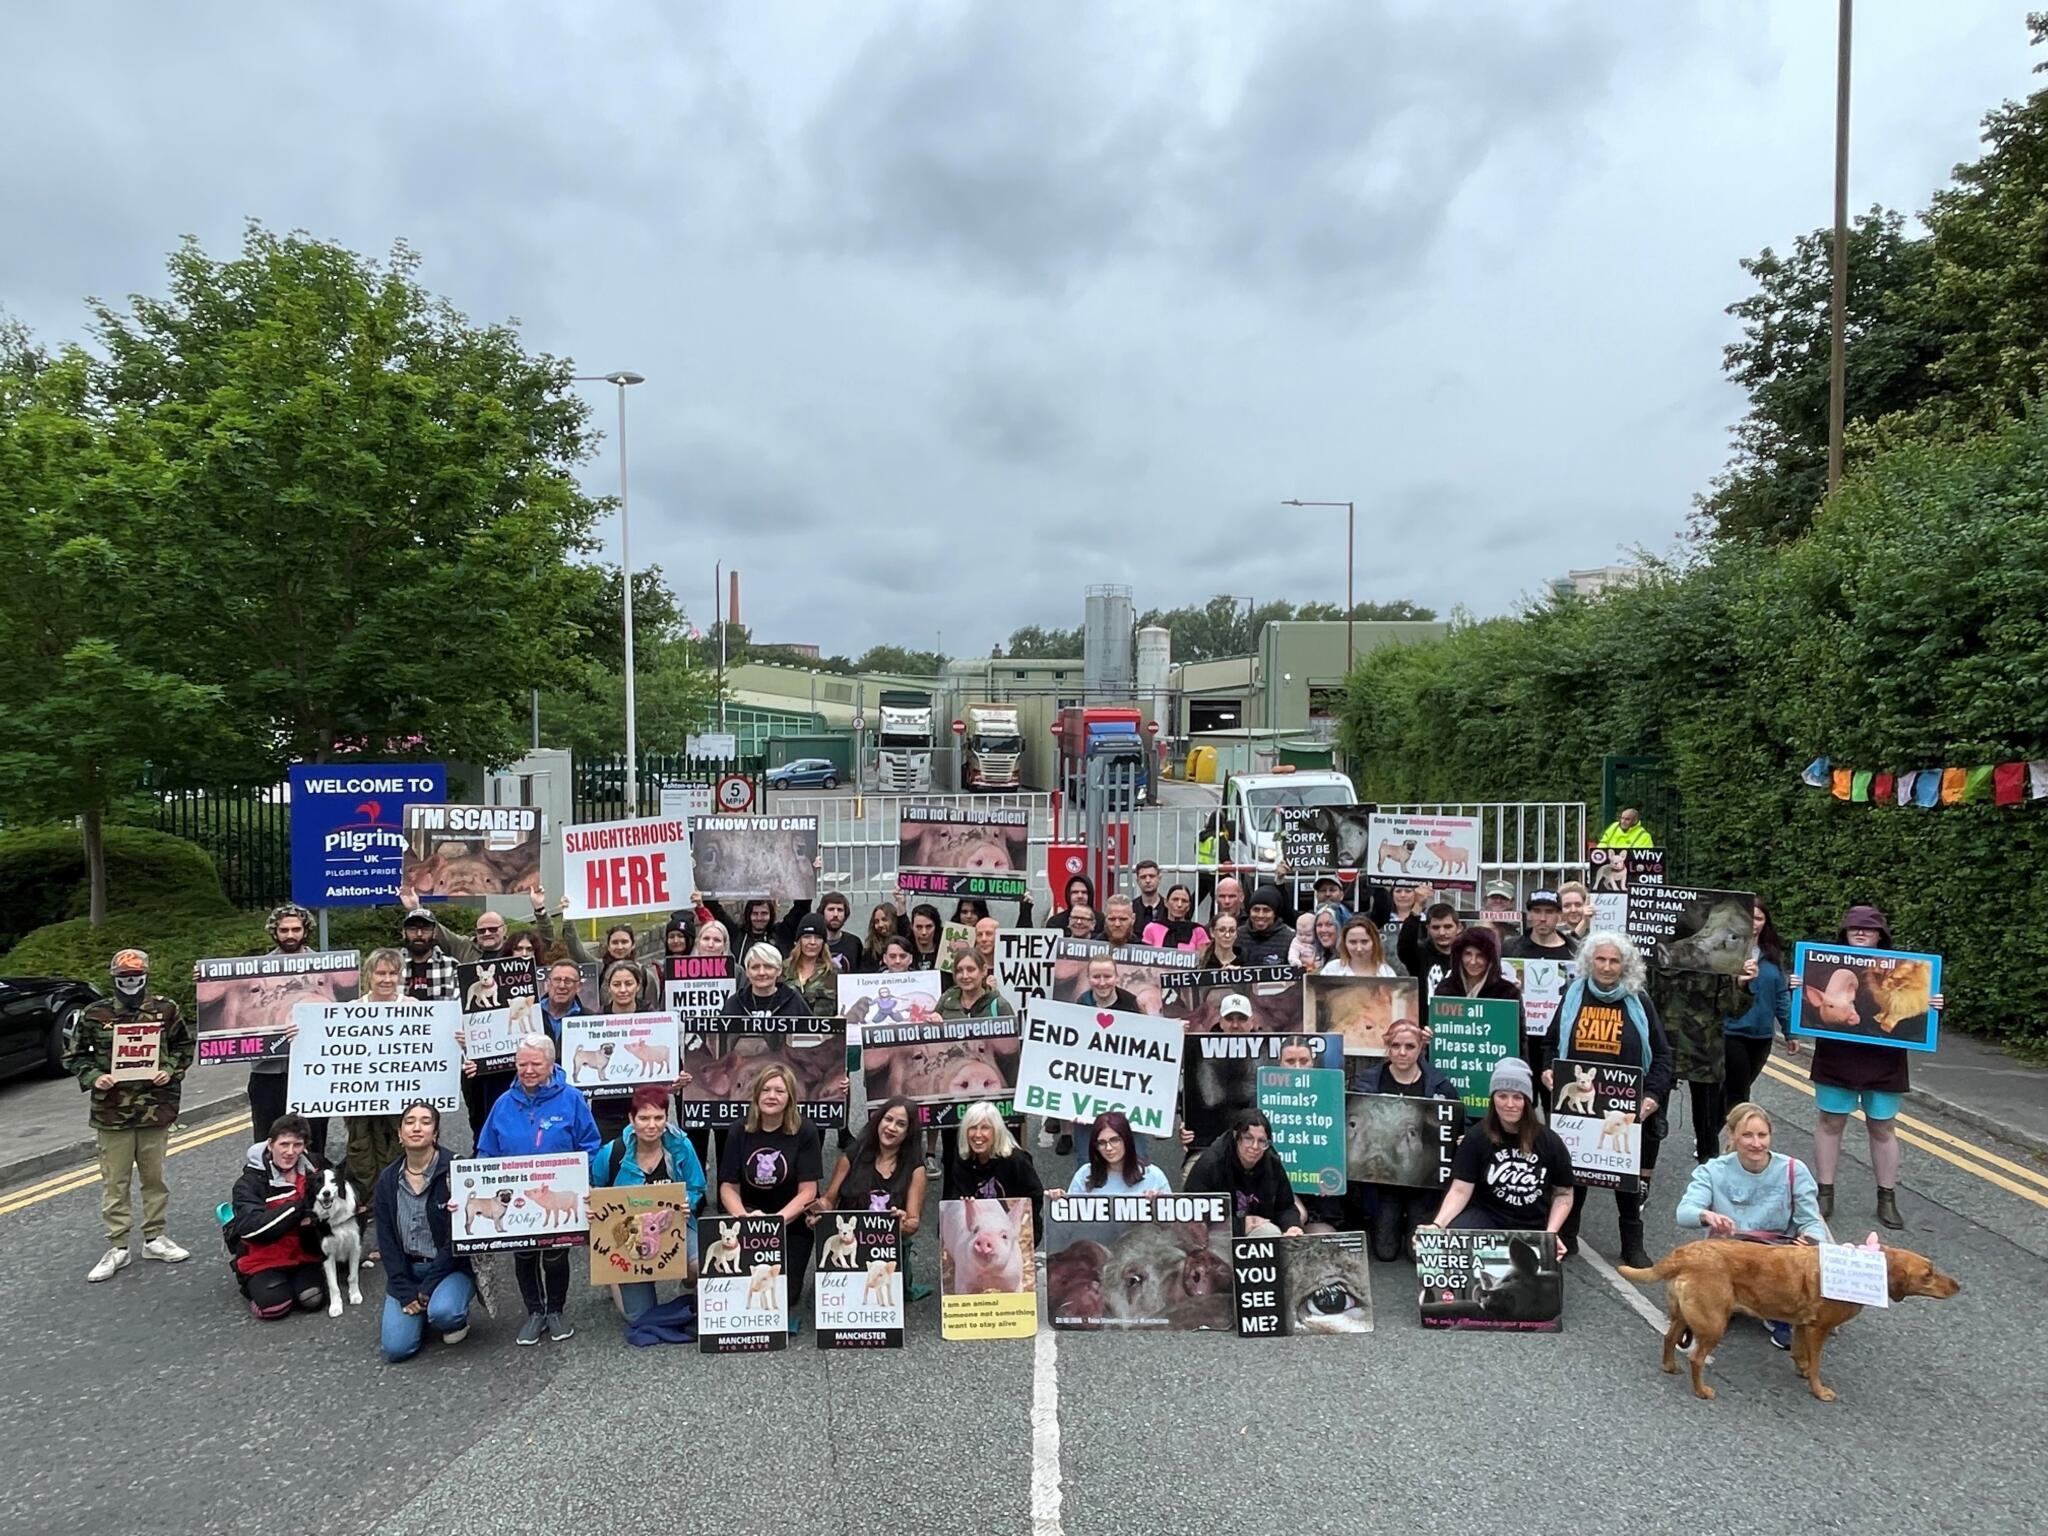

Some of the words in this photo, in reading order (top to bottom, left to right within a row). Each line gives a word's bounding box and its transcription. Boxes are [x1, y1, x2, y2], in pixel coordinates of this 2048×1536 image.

[305, 779, 404, 793] WELCOME
[408, 778, 433, 792] TO
[730, 783, 740, 796] 5
[412, 808, 444, 830] I'M
[450, 808, 535, 831] SCARED
[1284, 809, 1320, 819] DON'T
[705, 818, 748, 830] KNOW
[750, 818, 778, 830] YOU
[781, 818, 816, 830] CARE
[1285, 822, 1299, 831] BE
[566, 821, 684, 853] SLAUGHTERHOUSE
[1286, 833, 1326, 843] SORRY.
[1286, 845, 1312, 855] JUST
[1316, 845, 1330, 854] BE
[1633, 850, 1662, 862] Why
[364, 855, 379, 863] UK
[1286, 857, 1330, 867] VEGAN.
[325, 868, 368, 877] PILGRIM'S
[371, 868, 397, 876] PRIDE
[1639, 874, 1662, 884] ONE
[586, 853, 670, 909] HERE
[900, 876, 926, 890] SAVE
[930, 876, 948, 890] ME
[970, 879, 985, 892] GO
[988, 880, 1025, 894] VEGAN
[1630, 887, 1654, 896] NOT
[1657, 889, 1696, 900] BACON
[1630, 899, 1654, 909] NOT
[1656, 901, 1686, 912] HAM.
[1630, 911, 1637, 919] A
[1640, 912, 1676, 923] LIVING
[1629, 922, 1662, 934] BEING
[1665, 926, 1675, 934] IS
[1629, 934, 1656, 944] WHO
[1000, 935, 1057, 958] THEY
[210, 963, 232, 977] am
[236, 960, 258, 976] not
[262, 959, 280, 974] an
[284, 953, 356, 972] ingredient
[1131, 948, 1196, 968] ingredient
[1809, 951, 1840, 964] Love
[1844, 955, 1876, 968] them
[1880, 960, 1896, 969] all
[501, 961, 530, 972] Why
[674, 958, 728, 978] HONK
[498, 974, 532, 986] Love
[1000, 962, 1055, 986] WANT
[1161, 973, 1202, 987] THEY
[1211, 969, 1263, 984] TRUST
[510, 985, 534, 996] ONE
[673, 990, 730, 1007] MERCY
[1526, 1000, 1558, 1010] murder
[324, 1008, 338, 1019] IF
[344, 1006, 378, 1018] YOU
[385, 1006, 434, 1018] THINK
[1434, 1003, 1464, 1016] LOVE
[1468, 1006, 1483, 1017] all
[1527, 1011, 1547, 1019] here
[1581, 1006, 1623, 1022] ANIMAL
[325, 1024, 394, 1038] VEGANS
[400, 1024, 431, 1036] ARE
[686, 1018, 732, 1032] THEY
[742, 1019, 798, 1032] TRUST
[874, 1030, 894, 1042] am
[899, 1026, 919, 1041] not
[924, 1026, 940, 1038] an
[944, 1020, 1014, 1038] ingredient
[1434, 1023, 1491, 1036] animals?
[1576, 1020, 1623, 1042] SAVE
[602, 1030, 620, 1038] other
[1028, 1019, 1079, 1046] END
[1088, 1032, 1176, 1063] ANIMAL
[200, 1040, 236, 1057] SAVE
[240, 1038, 264, 1054] ME
[320, 1044, 372, 1056] LOUD,
[378, 1042, 433, 1055] LISTEN
[472, 1044, 492, 1054] THE
[1200, 1038, 1264, 1058] WHY
[1434, 1039, 1474, 1052] Please
[1479, 1042, 1506, 1056] stop
[304, 1064, 325, 1076] TO
[332, 1063, 362, 1074] THE
[368, 1060, 448, 1074] SCREAMS
[1434, 1058, 1457, 1070] and
[1461, 1059, 1483, 1071] ask
[1049, 1060, 1153, 1095] CRUELTY.
[1262, 1072, 1292, 1087] LOVE
[1295, 1074, 1310, 1088] all
[1603, 1068, 1637, 1085] Why
[330, 1081, 379, 1094] FROM
[385, 1080, 420, 1092] THIS
[594, 1088, 626, 1096] difference
[1598, 1084, 1636, 1098] Love
[1026, 1085, 1062, 1112] BE
[1262, 1093, 1318, 1107] animals?
[1608, 1098, 1636, 1110] ONE
[291, 1099, 390, 1114] SLAUGHTER
[684, 1104, 710, 1118] WE
[1306, 1112, 1332, 1128] stop
[1557, 1116, 1584, 1130] but
[1288, 1130, 1309, 1144] ask
[1313, 1134, 1328, 1145] us
[457, 1164, 472, 1172] One
[474, 1164, 481, 1172] is
[482, 1164, 500, 1174] your
[502, 1160, 534, 1170] beloved
[1582, 1153, 1632, 1168] OTHER?
[482, 1176, 496, 1185] The
[498, 1174, 518, 1184] other
[520, 1174, 528, 1182] is
[594, 1202, 626, 1221] Why
[658, 1201, 681, 1211] one
[1051, 1198, 1109, 1222] GIVE
[1114, 1198, 1152, 1222] ME
[1158, 1198, 1225, 1222] HOPE
[747, 1220, 780, 1236] Why
[864, 1216, 895, 1231] Why
[744, 1236, 780, 1248] Love
[859, 1231, 896, 1244] Love
[1421, 1236, 1469, 1249] WHAT
[457, 1244, 470, 1252] The
[472, 1242, 488, 1251] only
[490, 1240, 528, 1249] difference
[870, 1247, 896, 1258] ONE
[1236, 1244, 1274, 1258] CAN
[754, 1251, 781, 1262] ONE
[1422, 1256, 1469, 1269] WERE
[822, 1272, 848, 1288] but
[1236, 1268, 1276, 1284] YOU
[1423, 1274, 1468, 1288] DOG?
[704, 1279, 732, 1293] but
[704, 1300, 728, 1312] Eat
[822, 1294, 845, 1306] Eat
[1242, 1292, 1275, 1308] SEE
[704, 1317, 726, 1328] THE
[730, 1314, 780, 1328] OTHER?
[822, 1312, 843, 1324] THE
[847, 1312, 896, 1324] OTHER?
[996, 1310, 1035, 1318] something
[1242, 1316, 1278, 1332] ME?
[718, 1336, 770, 1345] MANCHESTER
[836, 1332, 886, 1340] MANCHESTER
